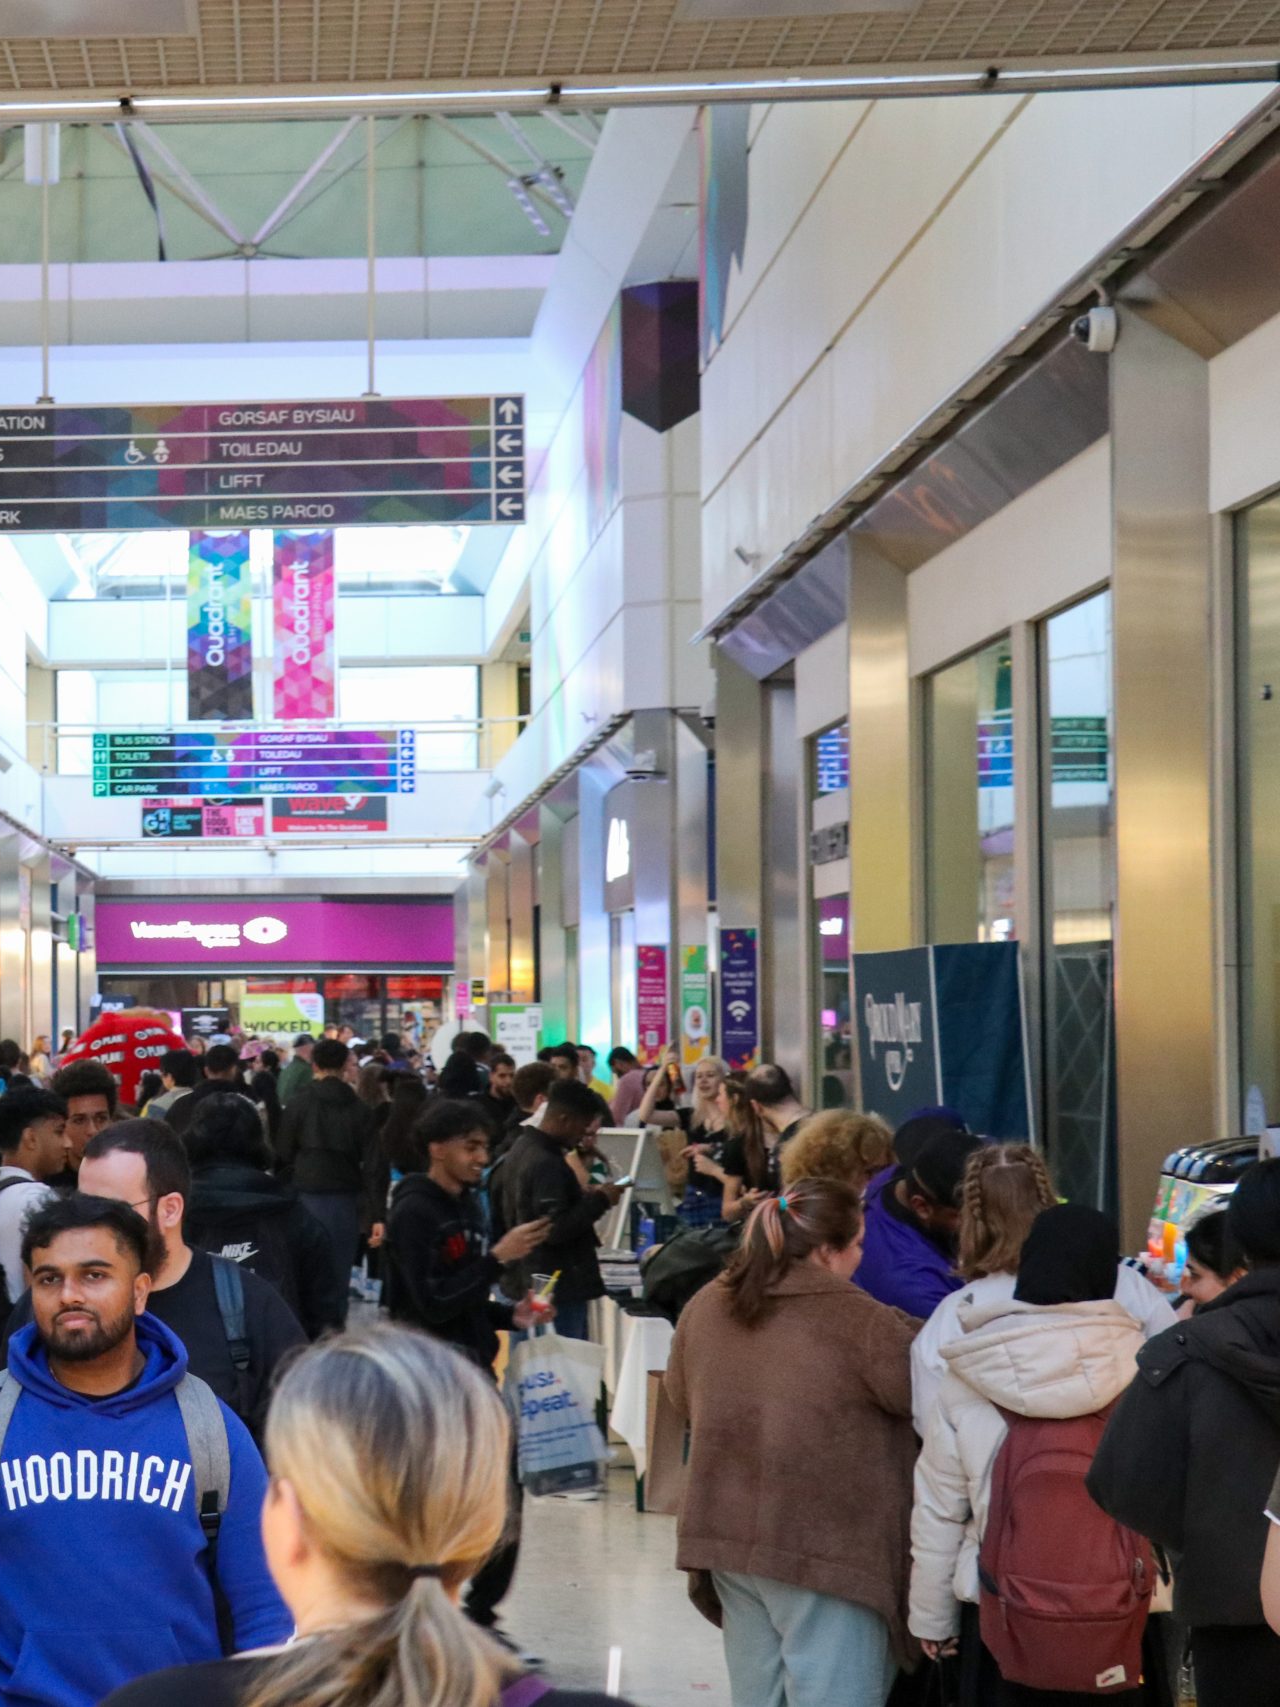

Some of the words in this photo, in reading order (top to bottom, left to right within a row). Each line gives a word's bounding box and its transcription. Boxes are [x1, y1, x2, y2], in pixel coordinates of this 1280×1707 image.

[218, 410, 288, 426] GORSAF
[292, 408, 355, 424] BYSIAU
[220, 441, 302, 457] TOILEDAU
[219, 474, 264, 489] LIFFT
[219, 505, 269, 521] MAES
[272, 503, 335, 519] PARCIO
[203, 562, 225, 666] Quadrant
[288, 560, 311, 666] Quadrant
[114, 736, 133, 746] BUS
[134, 736, 170, 745] STATION
[258, 735, 294, 744] GORSAF
[296, 734, 328, 743] BYSIAU
[114, 752, 150, 761] TOILETS
[114, 768, 134, 777] LIFT
[114, 785, 134, 794] CAR
[135, 784, 158, 793] PARK
[244, 1020, 312, 1033] WICKED
[221, 1242, 252, 1258] NIKE
[1, 1449, 191, 1512] HOODRICH
